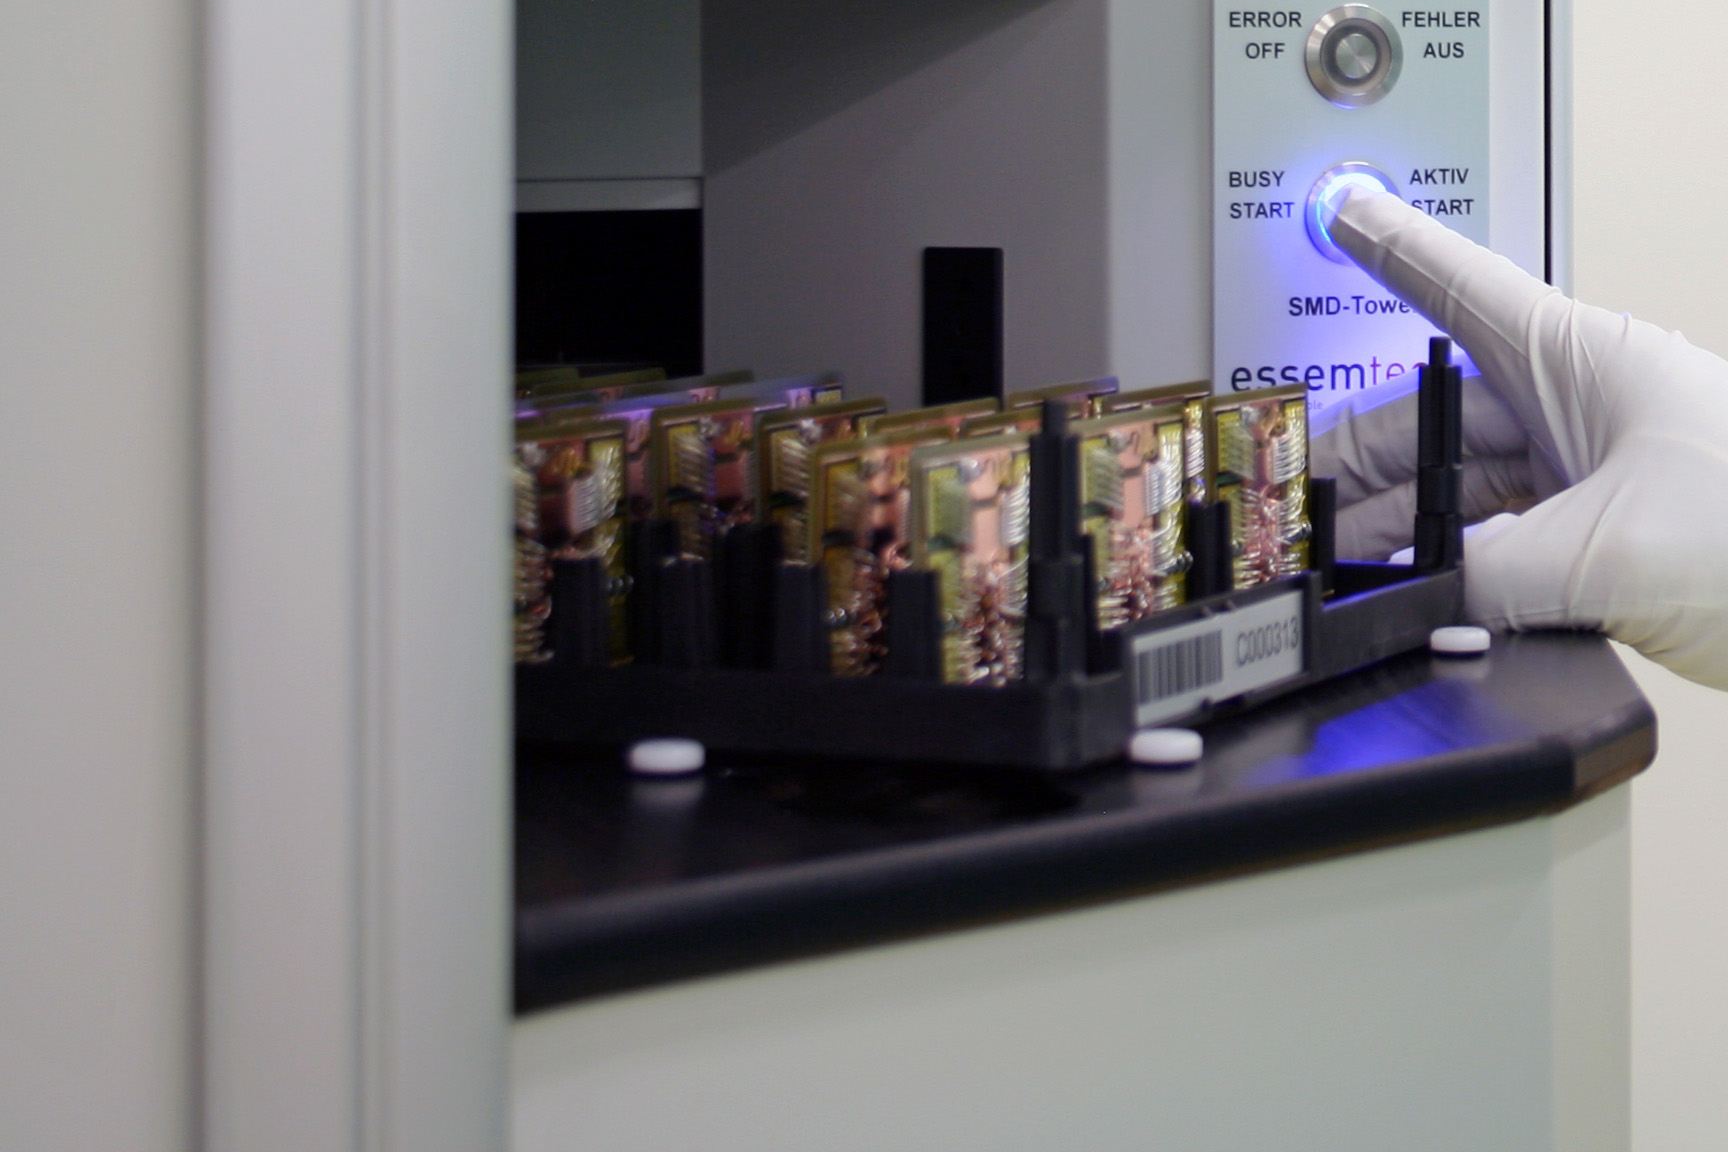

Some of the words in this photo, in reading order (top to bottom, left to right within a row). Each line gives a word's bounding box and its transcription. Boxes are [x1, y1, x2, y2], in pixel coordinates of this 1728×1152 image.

[1229, 12, 1302, 28] ERROR
[1402, 11, 1481, 27] FEHLER
[1245, 43, 1285, 59] OFF
[1423, 42, 1465, 58] AUS
[1229, 171, 1285, 187] BUSY
[1409, 169, 1469, 185] AKTIV
[1230, 202, 1295, 219] START
[1411, 199, 1474, 216] START
[1288, 295, 1417, 316] SMD-Towe
[1231, 356, 1429, 391] essemte
[1236, 615, 1300, 667] C000313
